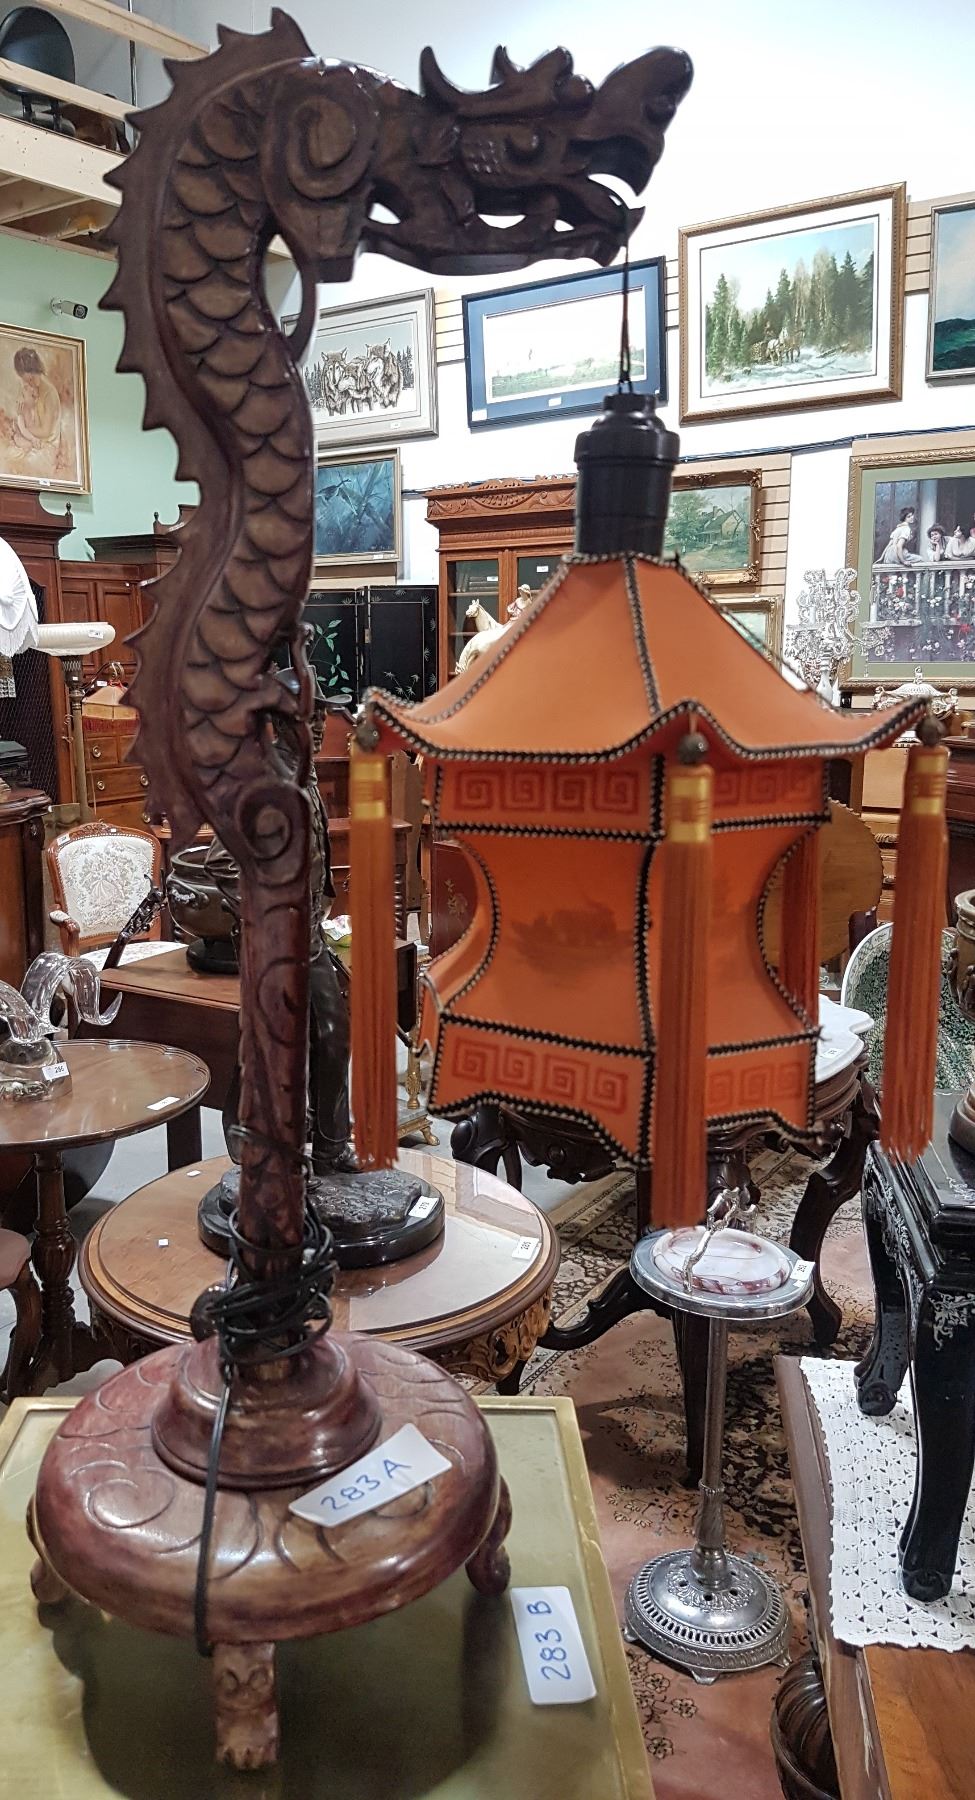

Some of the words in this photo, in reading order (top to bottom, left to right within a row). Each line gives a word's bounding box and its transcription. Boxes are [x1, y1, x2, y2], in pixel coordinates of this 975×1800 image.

[320, 1474, 381, 1511] 283
[383, 1458, 412, 1479] A
[526, 1600, 552, 1615] B
[534, 1628, 572, 1680] 283
